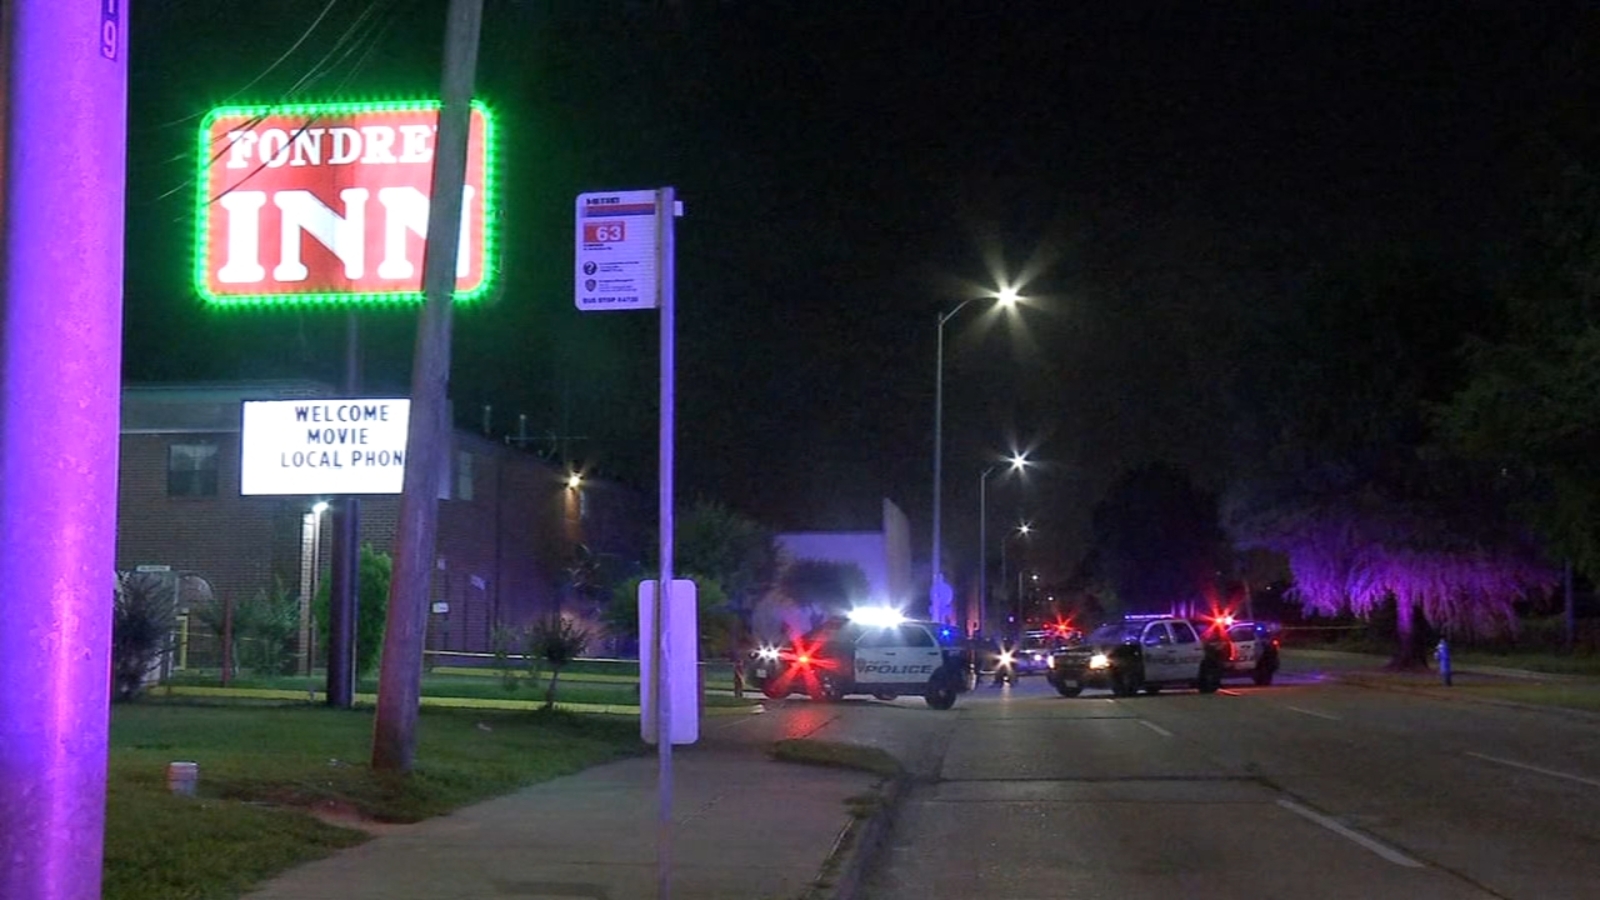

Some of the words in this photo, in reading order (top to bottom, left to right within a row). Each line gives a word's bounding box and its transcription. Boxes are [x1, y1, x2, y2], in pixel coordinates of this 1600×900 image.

[226, 124, 438, 169] FONDRE
[217, 184, 475, 283] INN
[596, 226, 621, 241] 63
[295, 404, 389, 422] WELCOME
[307, 428, 369, 444] MOVIE
[281, 450, 343, 467] LOCAL
[865, 665, 933, 674] POLICE
